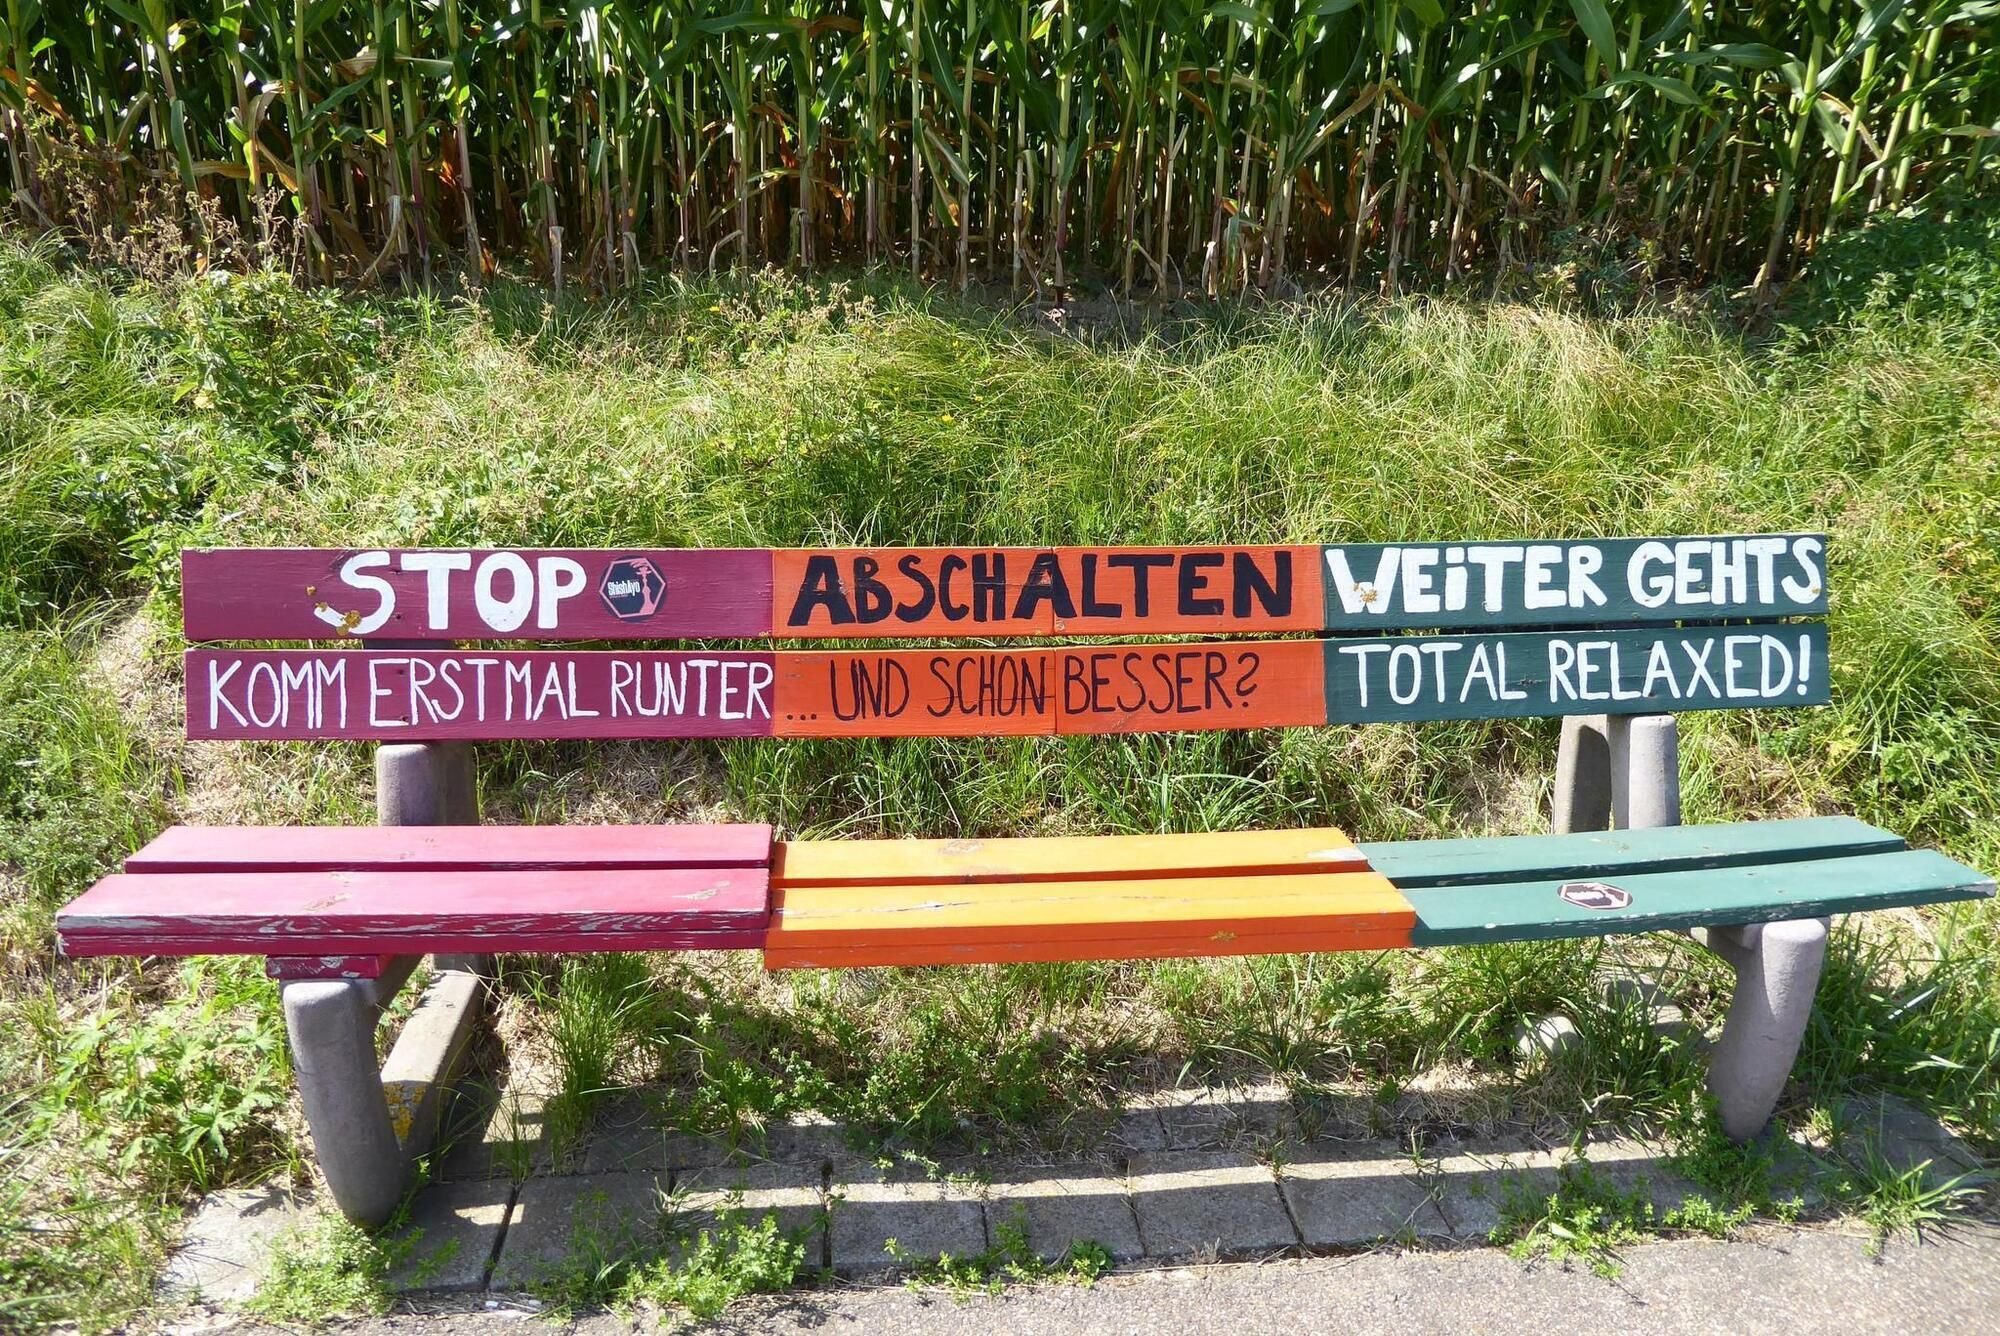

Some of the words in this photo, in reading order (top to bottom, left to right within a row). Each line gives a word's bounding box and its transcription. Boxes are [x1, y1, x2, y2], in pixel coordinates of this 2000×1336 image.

[313, 551, 587, 634] STOP
[787, 551, 1293, 627] ABSCHALTEN
[1627, 538, 1824, 607] GEHTS
[208, 658, 348, 730] KOMM
[369, 657, 599, 729] ERSTMAL
[611, 658, 775, 721] RUNTER
[927, 655, 1046, 717] SCHON
[1063, 651, 1261, 715] BESSER?
[1338, 640, 1528, 708] TOTAL
[1548, 633, 1812, 703] RELAXED!
